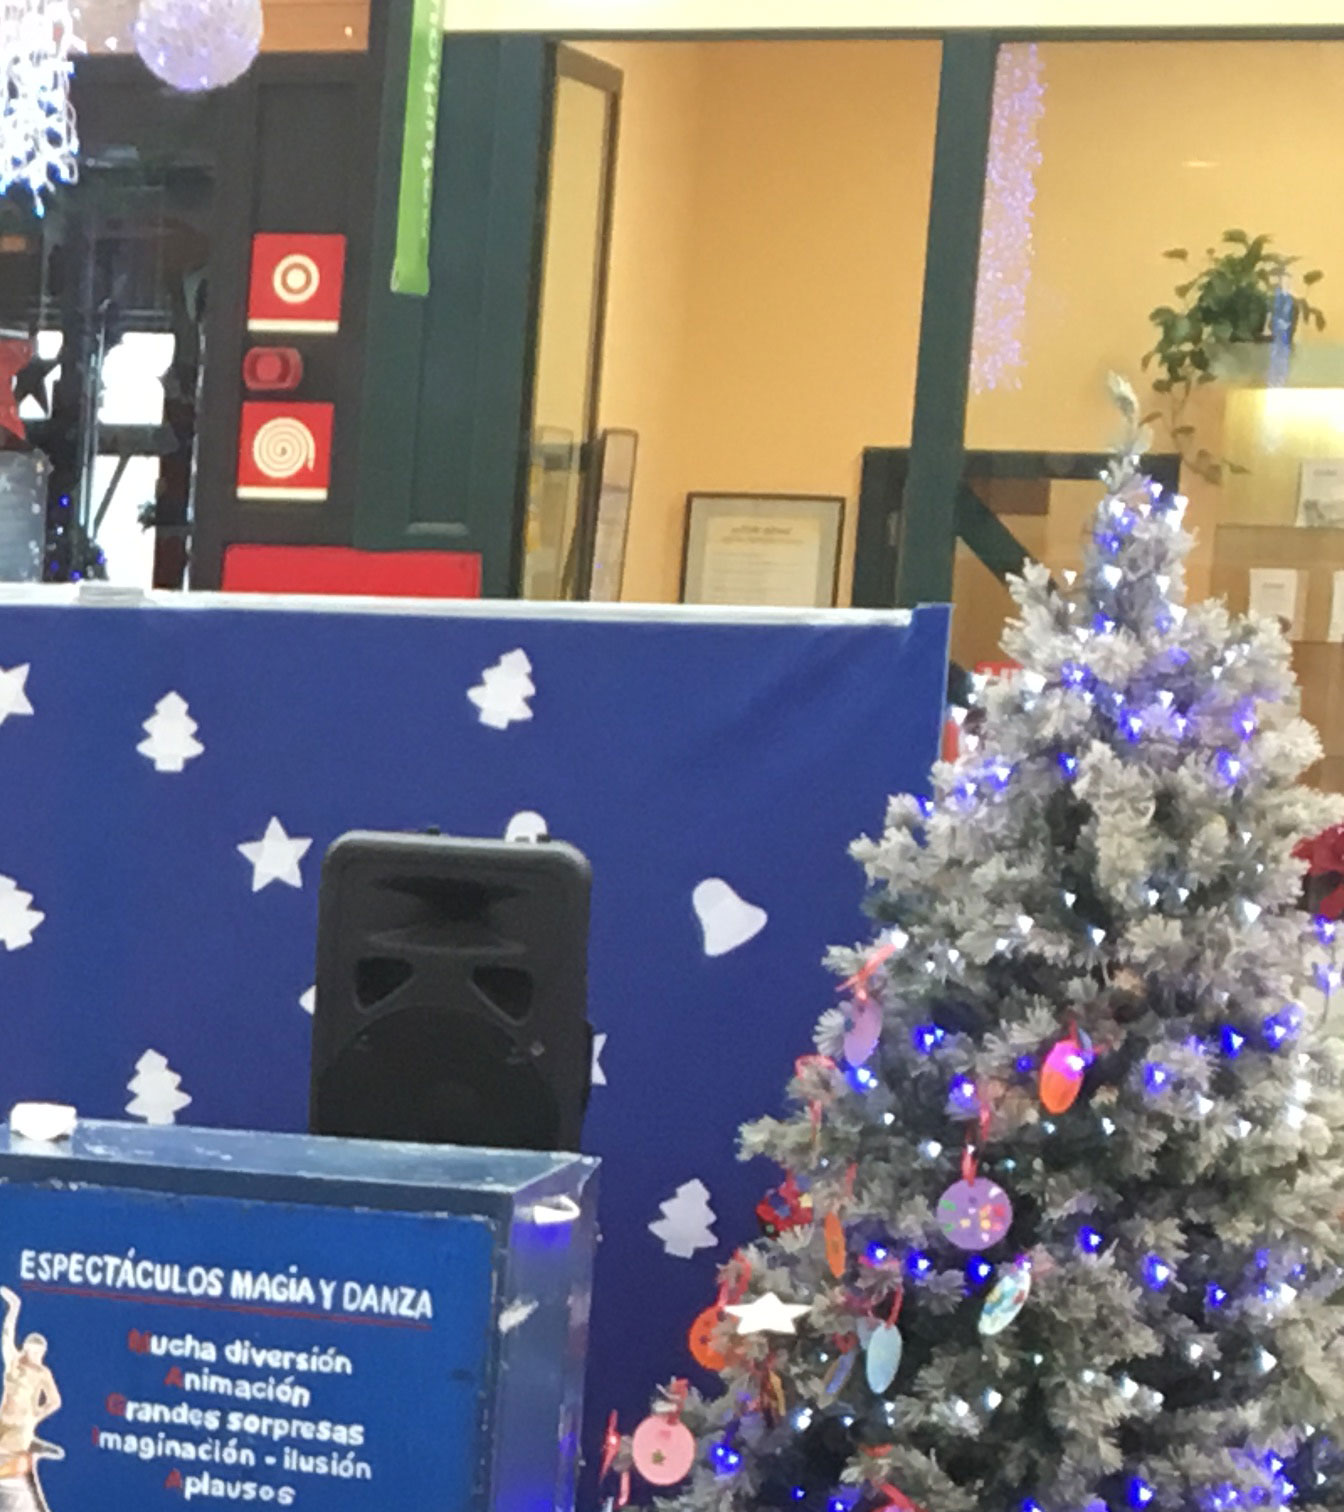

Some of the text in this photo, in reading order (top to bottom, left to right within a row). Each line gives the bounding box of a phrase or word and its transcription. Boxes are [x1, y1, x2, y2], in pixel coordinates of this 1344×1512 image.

[20, 1248, 223, 1296] ESPECTÁCULOS
[319, 1279, 338, 1311] Y
[343, 1281, 433, 1319] DANZA
[128, 1328, 353, 1375] Mucha diversión
[164, 1366, 311, 1408] Animación
[106, 1392, 365, 1446] Grandes sorpresas
[91, 1426, 256, 1467] Imaginación
[283, 1446, 372, 1480] ilusión
[165, 1468, 296, 1505] Aplausos
